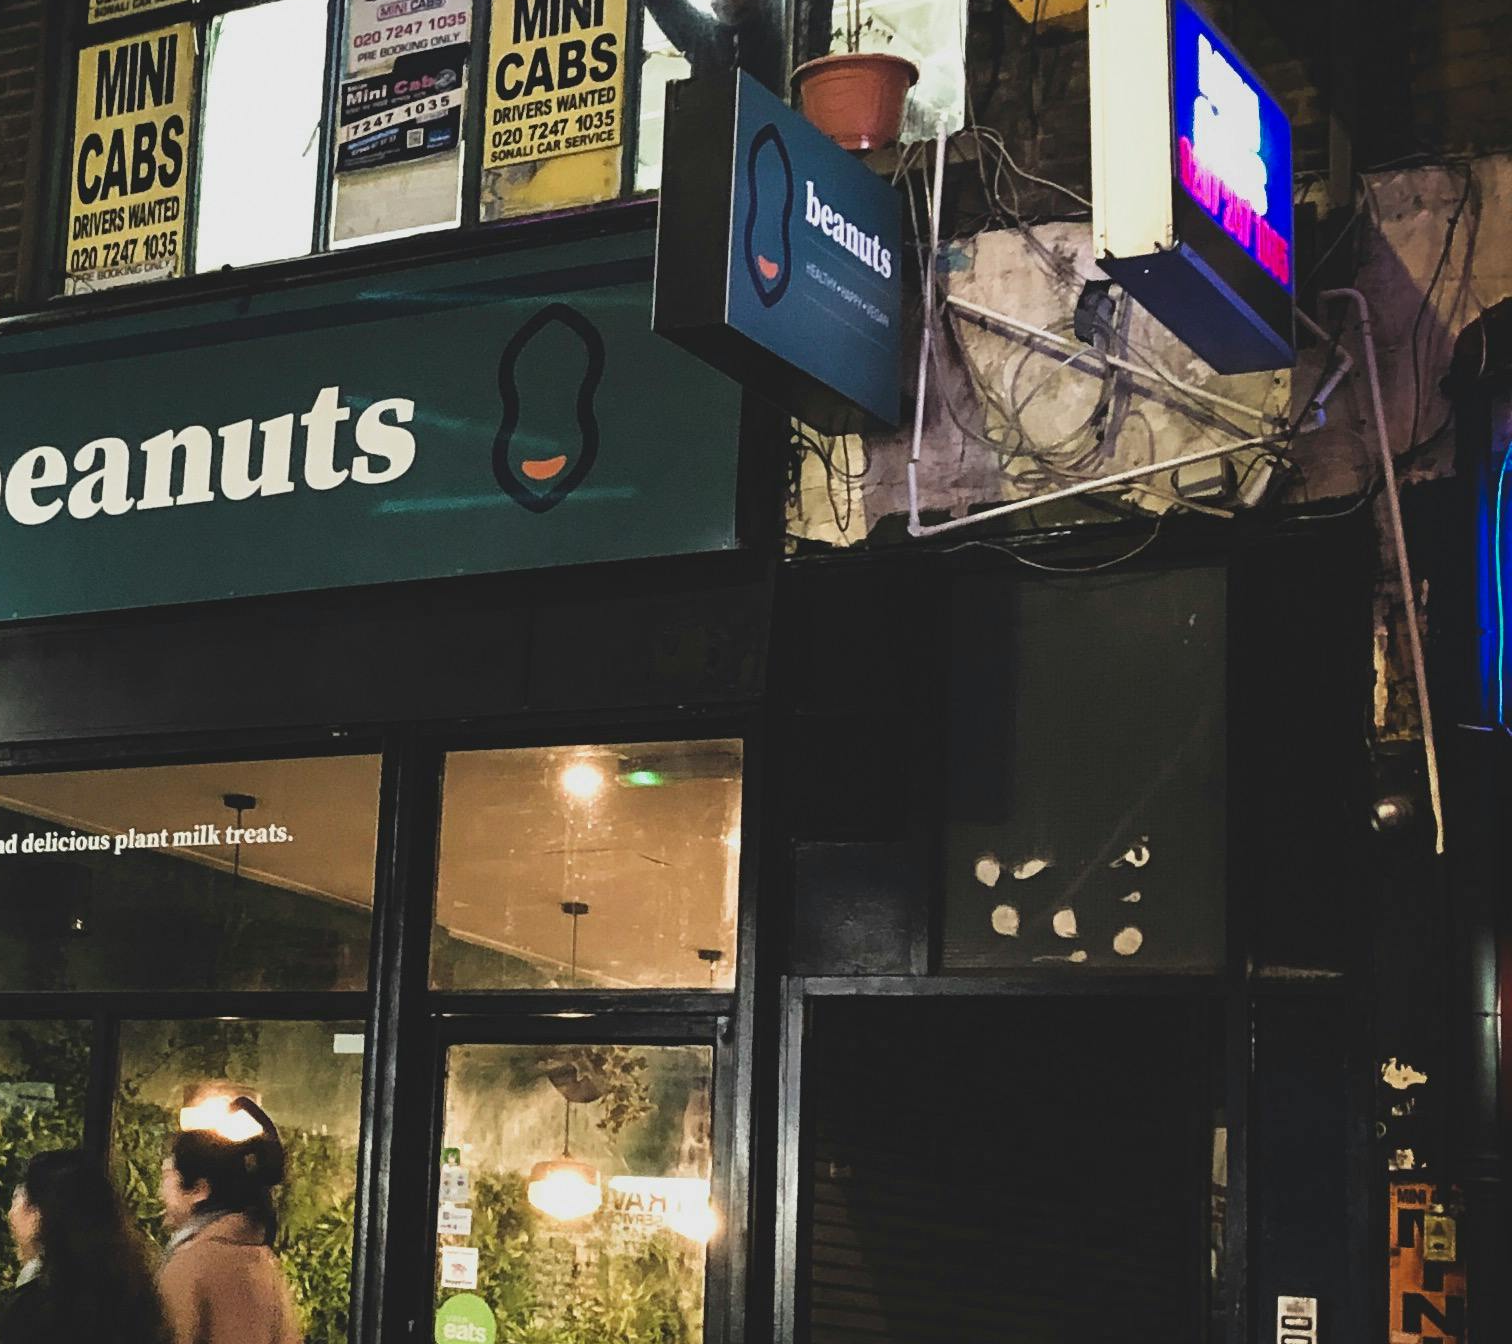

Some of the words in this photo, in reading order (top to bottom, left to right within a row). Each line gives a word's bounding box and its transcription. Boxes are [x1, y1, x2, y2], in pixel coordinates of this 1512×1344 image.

[353, 31, 381, 49] 020
[385, 21, 423, 41] 7247
[429, 11, 467, 30] 1035
[358, 50, 377, 62] PRE
[380, 38, 428, 58] BOOKING
[430, 31, 461, 46] ONLY
[94, 34, 178, 121] MINI
[495, 32, 618, 101] CABS
[346, 84, 388, 106] Mini
[493, 98, 552, 126] DRIVERS
[556, 86, 616, 113] WANTED
[351, 112, 394, 136] 7247
[404, 95, 450, 117] 1035
[492, 126, 523, 149] 020
[528, 118, 569, 142] 7247
[575, 109, 615, 132] 1035
[77, 114, 184, 205] CABS
[490, 143, 534, 163] SONALI
[537, 136, 561, 154] CAR
[565, 129, 614, 148] SERVICE
[72, 206, 124, 241] DRIVERS
[128, 195, 180, 229] WANTED
[805, 180, 892, 279] beanuts
[70, 245, 98, 274] 020
[102, 238, 138, 268] 7247
[143, 231, 178, 258] 1035
[96, 262, 142, 281] BOOKING
[144, 258, 173, 273] ONLY
[21, 829, 110, 854] delicious
[114, 827, 169, 855] plant
[173, 824, 221, 847] milk
[226, 823, 294, 845] treats.
[443, 1322, 487, 1344] eats
